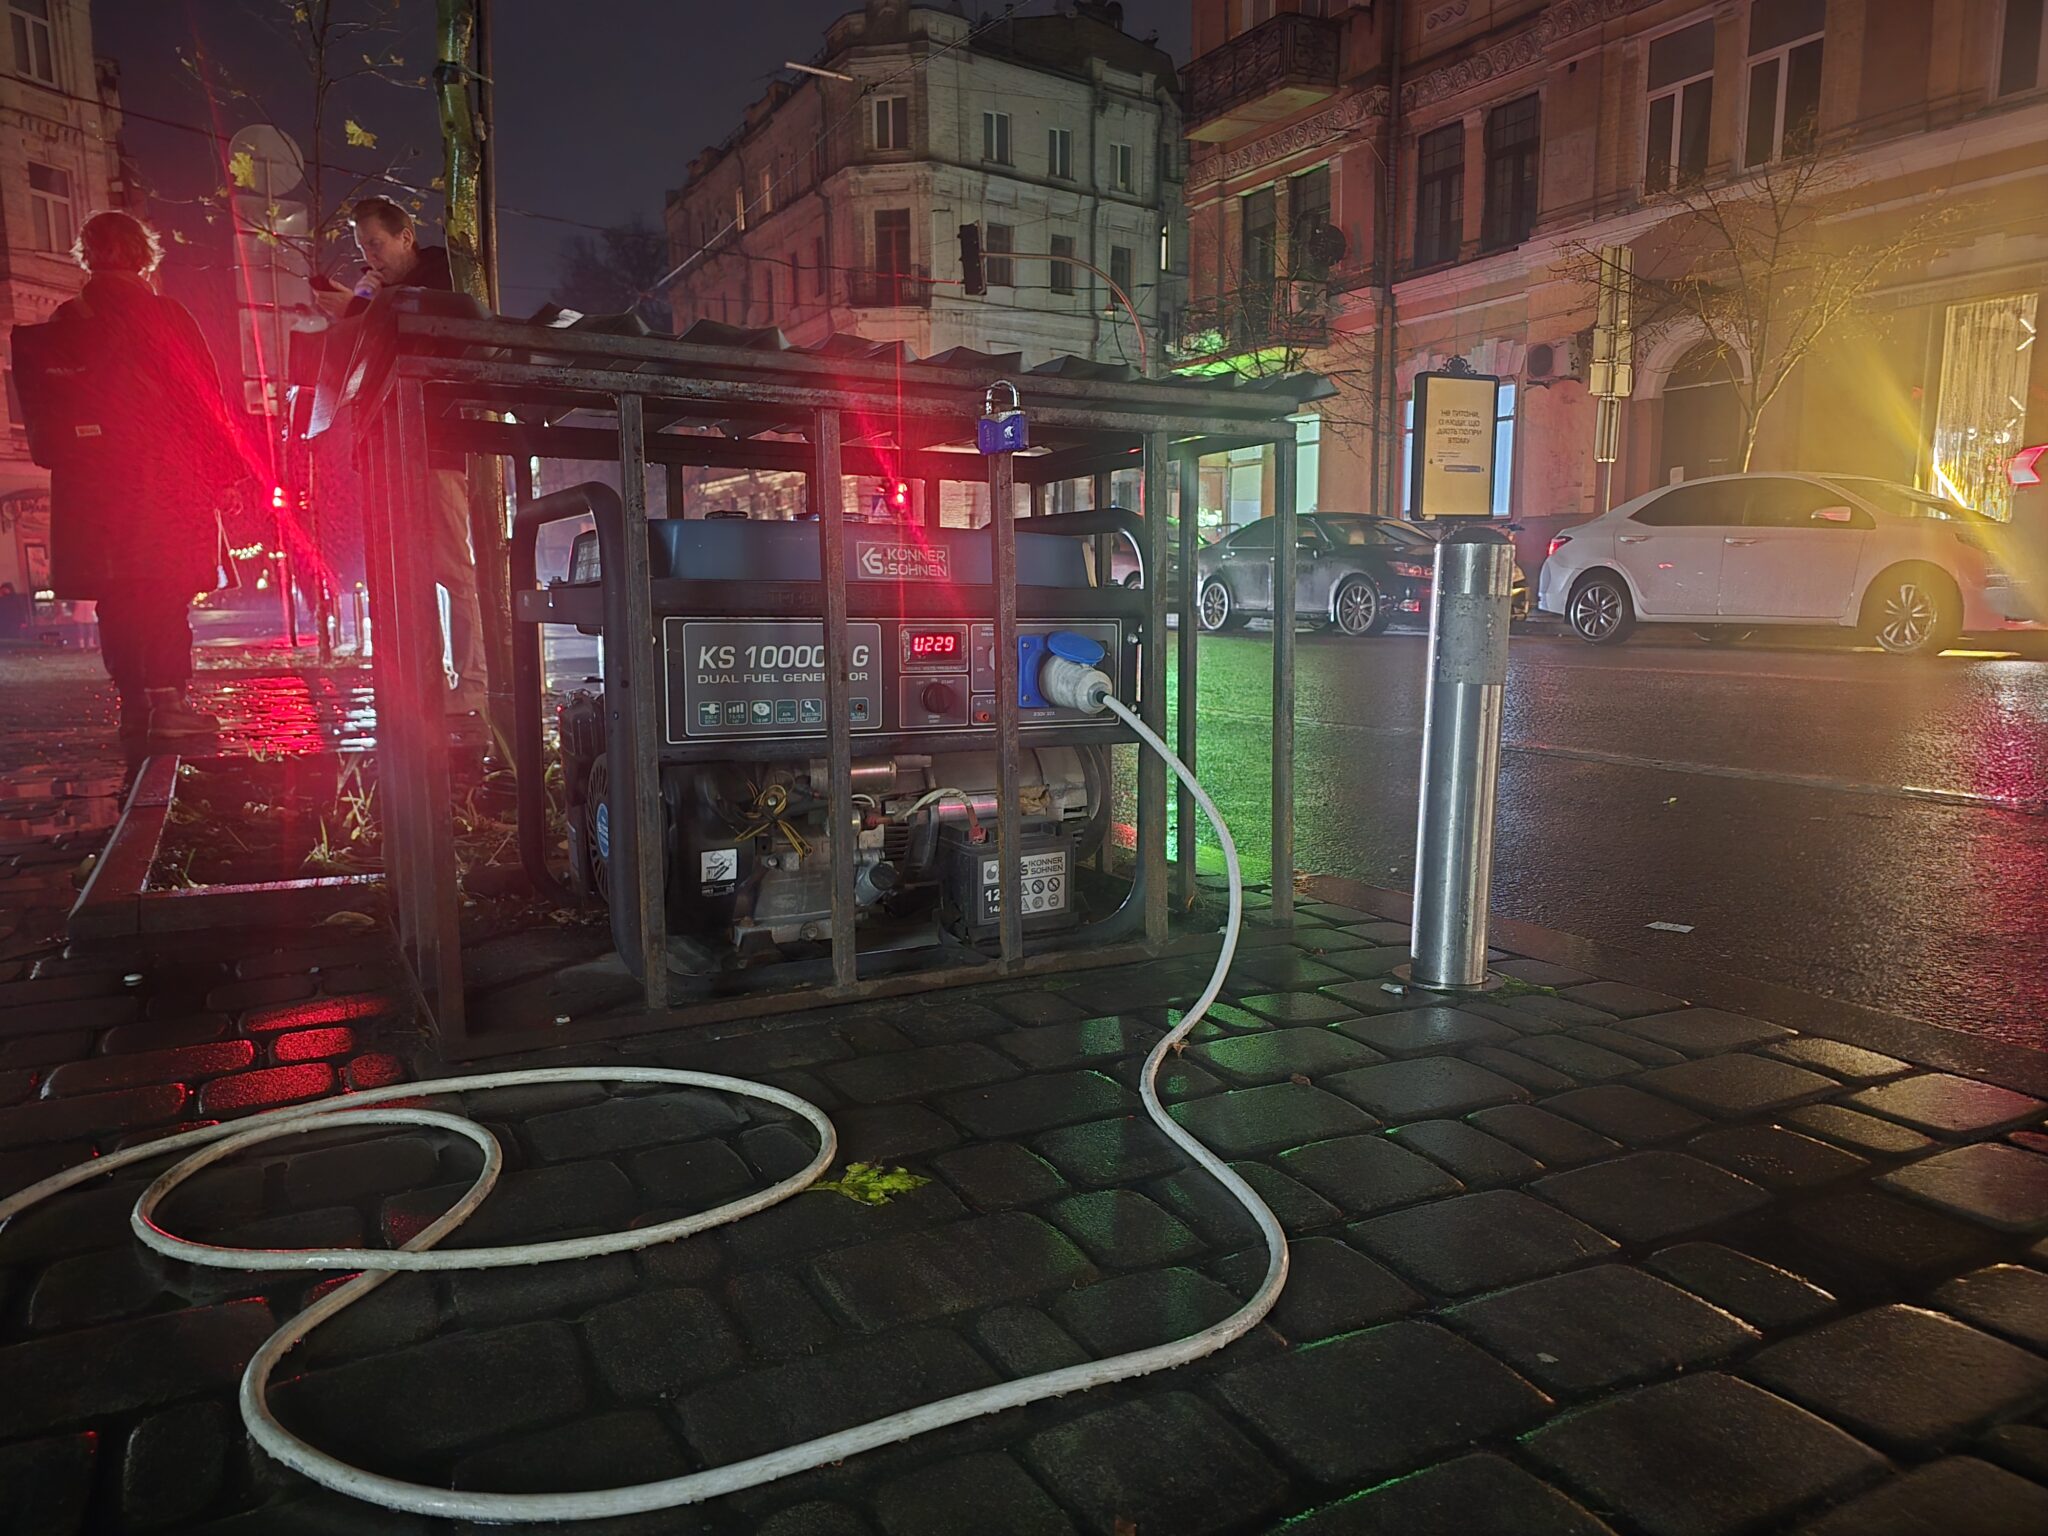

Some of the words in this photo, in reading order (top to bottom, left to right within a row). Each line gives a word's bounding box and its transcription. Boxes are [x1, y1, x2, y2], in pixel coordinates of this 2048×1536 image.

[698, 645, 736, 670] KS
[744, 644, 825, 669] 10000
[697, 674, 739, 684] DUAL
[743, 673, 779, 683] FUEL
